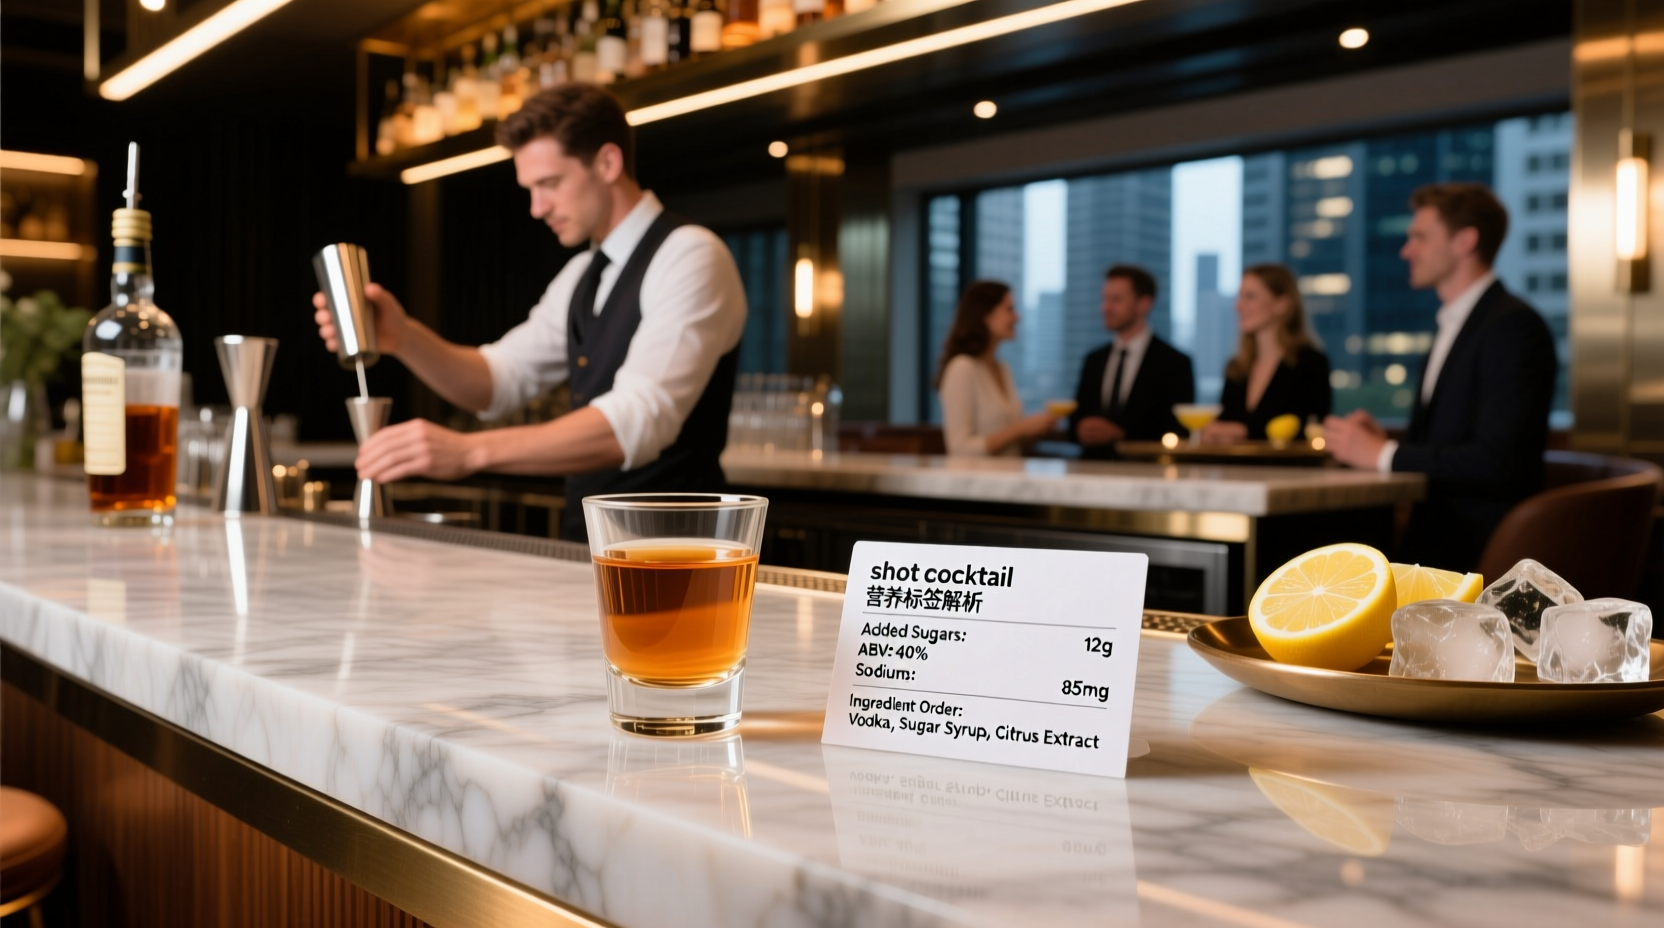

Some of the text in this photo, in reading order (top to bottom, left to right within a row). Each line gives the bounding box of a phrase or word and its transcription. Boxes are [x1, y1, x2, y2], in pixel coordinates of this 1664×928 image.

[871, 561, 1013, 587] shot cocktail
[866, 585, 983, 613] 营养标签解析
[858, 643, 928, 660] ABV: 40%
[861, 622, 1112, 657] Added Sugars: 12g
[856, 663, 1109, 702] Sodium: 85mg
[920, 700, 962, 717] Order:
[849, 713, 1099, 749] Vodka, Sugar Syrup, Citrus Extract
